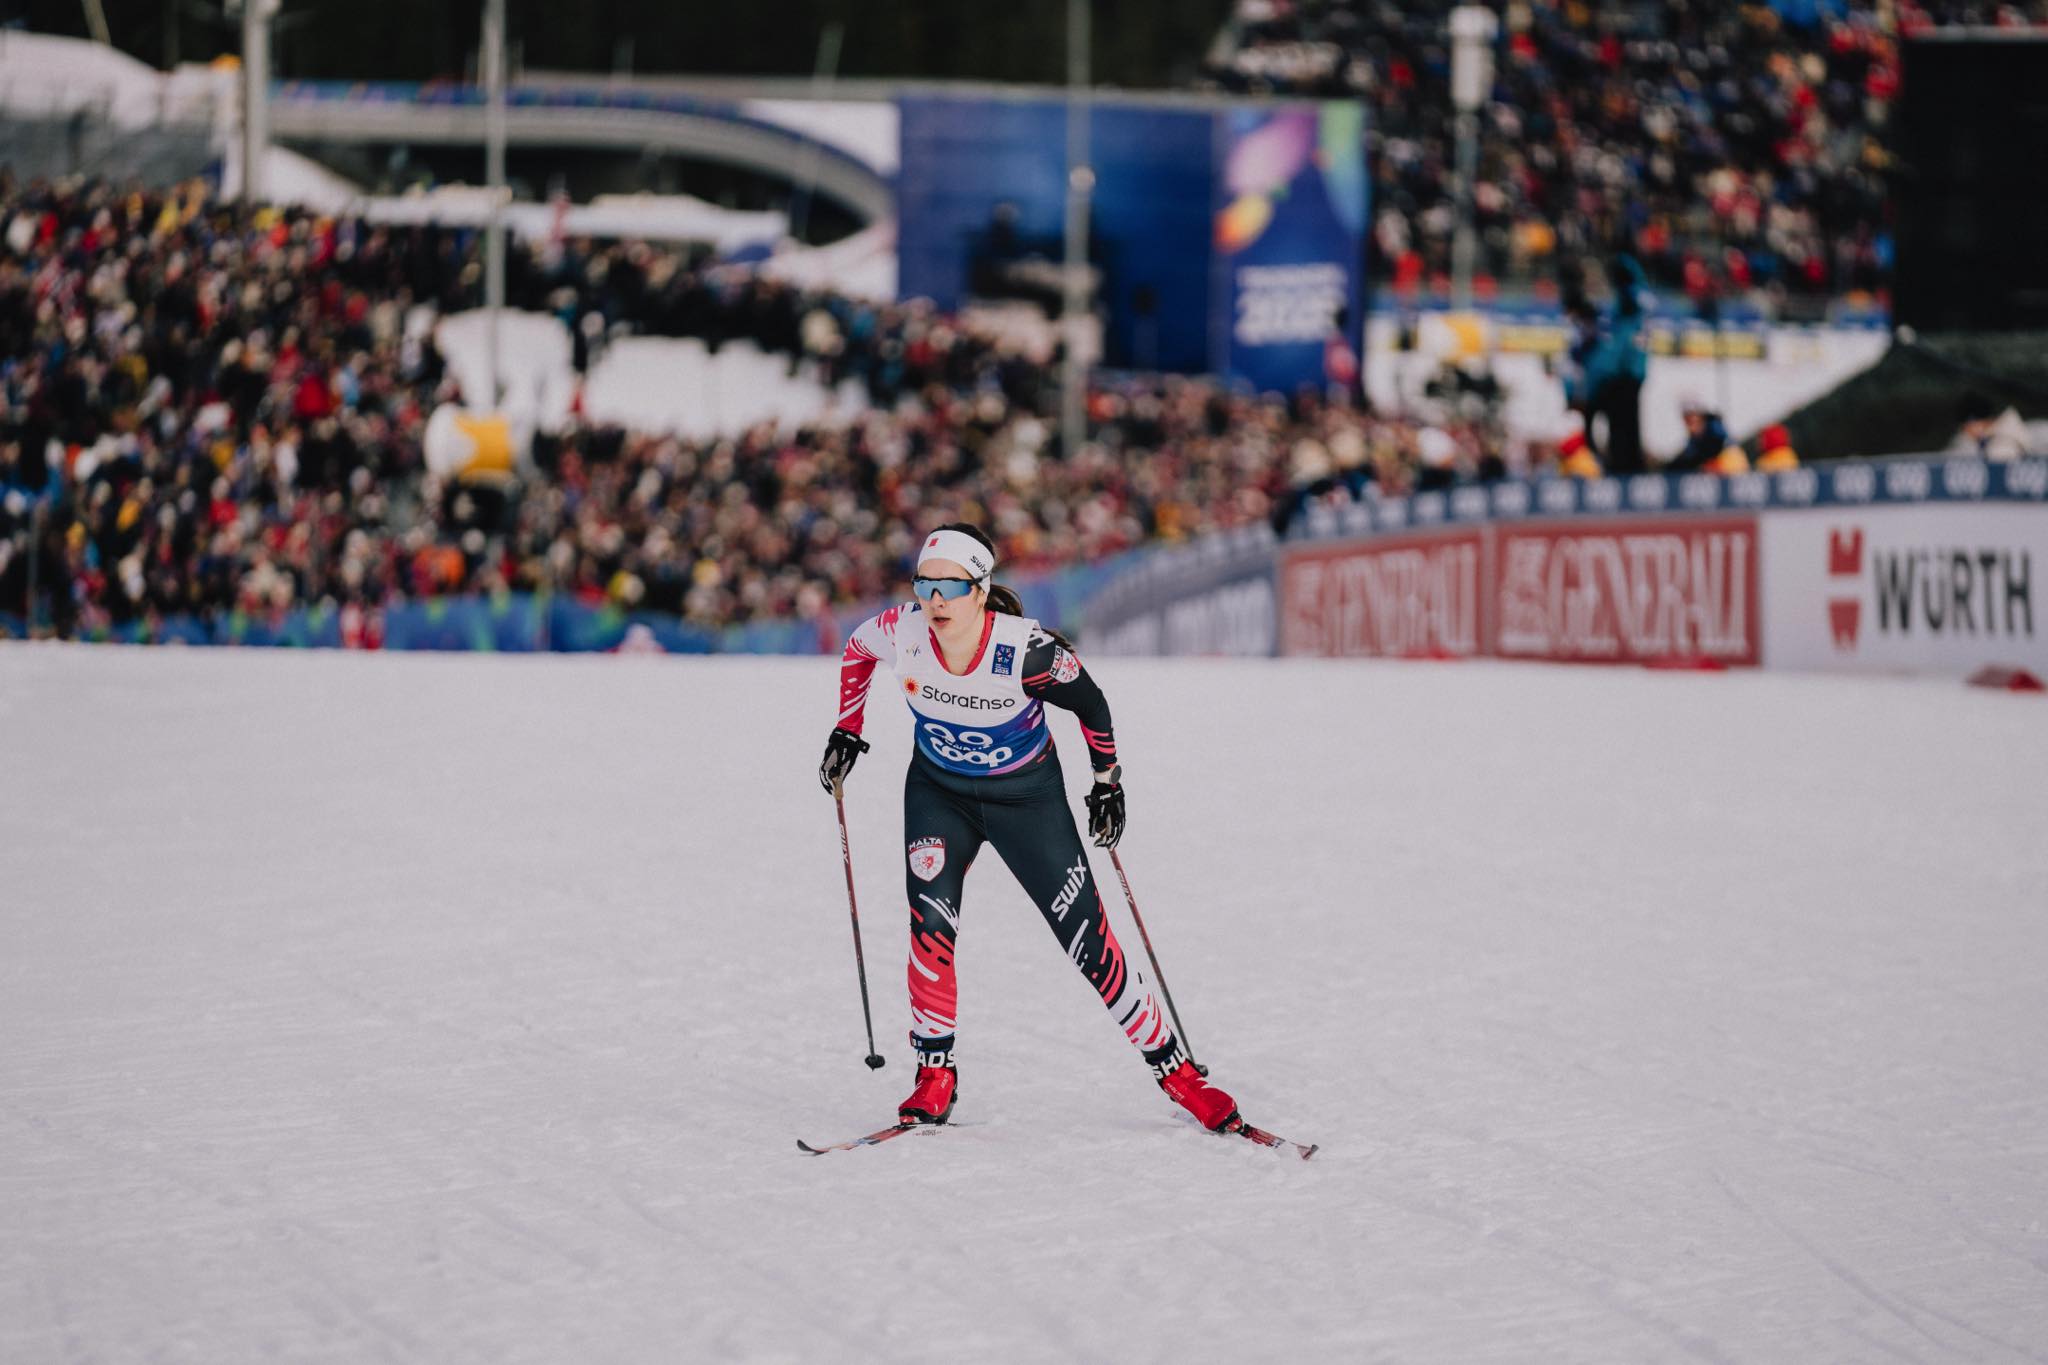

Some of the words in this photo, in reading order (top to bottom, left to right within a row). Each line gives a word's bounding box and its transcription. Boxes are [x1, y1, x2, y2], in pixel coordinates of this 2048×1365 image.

[1547, 532, 1748, 655] GENERALI
[922, 685, 1016, 710] StoraEnso
[930, 736, 1013, 768] coop
[908, 837, 944, 848] MALTA
[1050, 854, 1088, 922] swix
